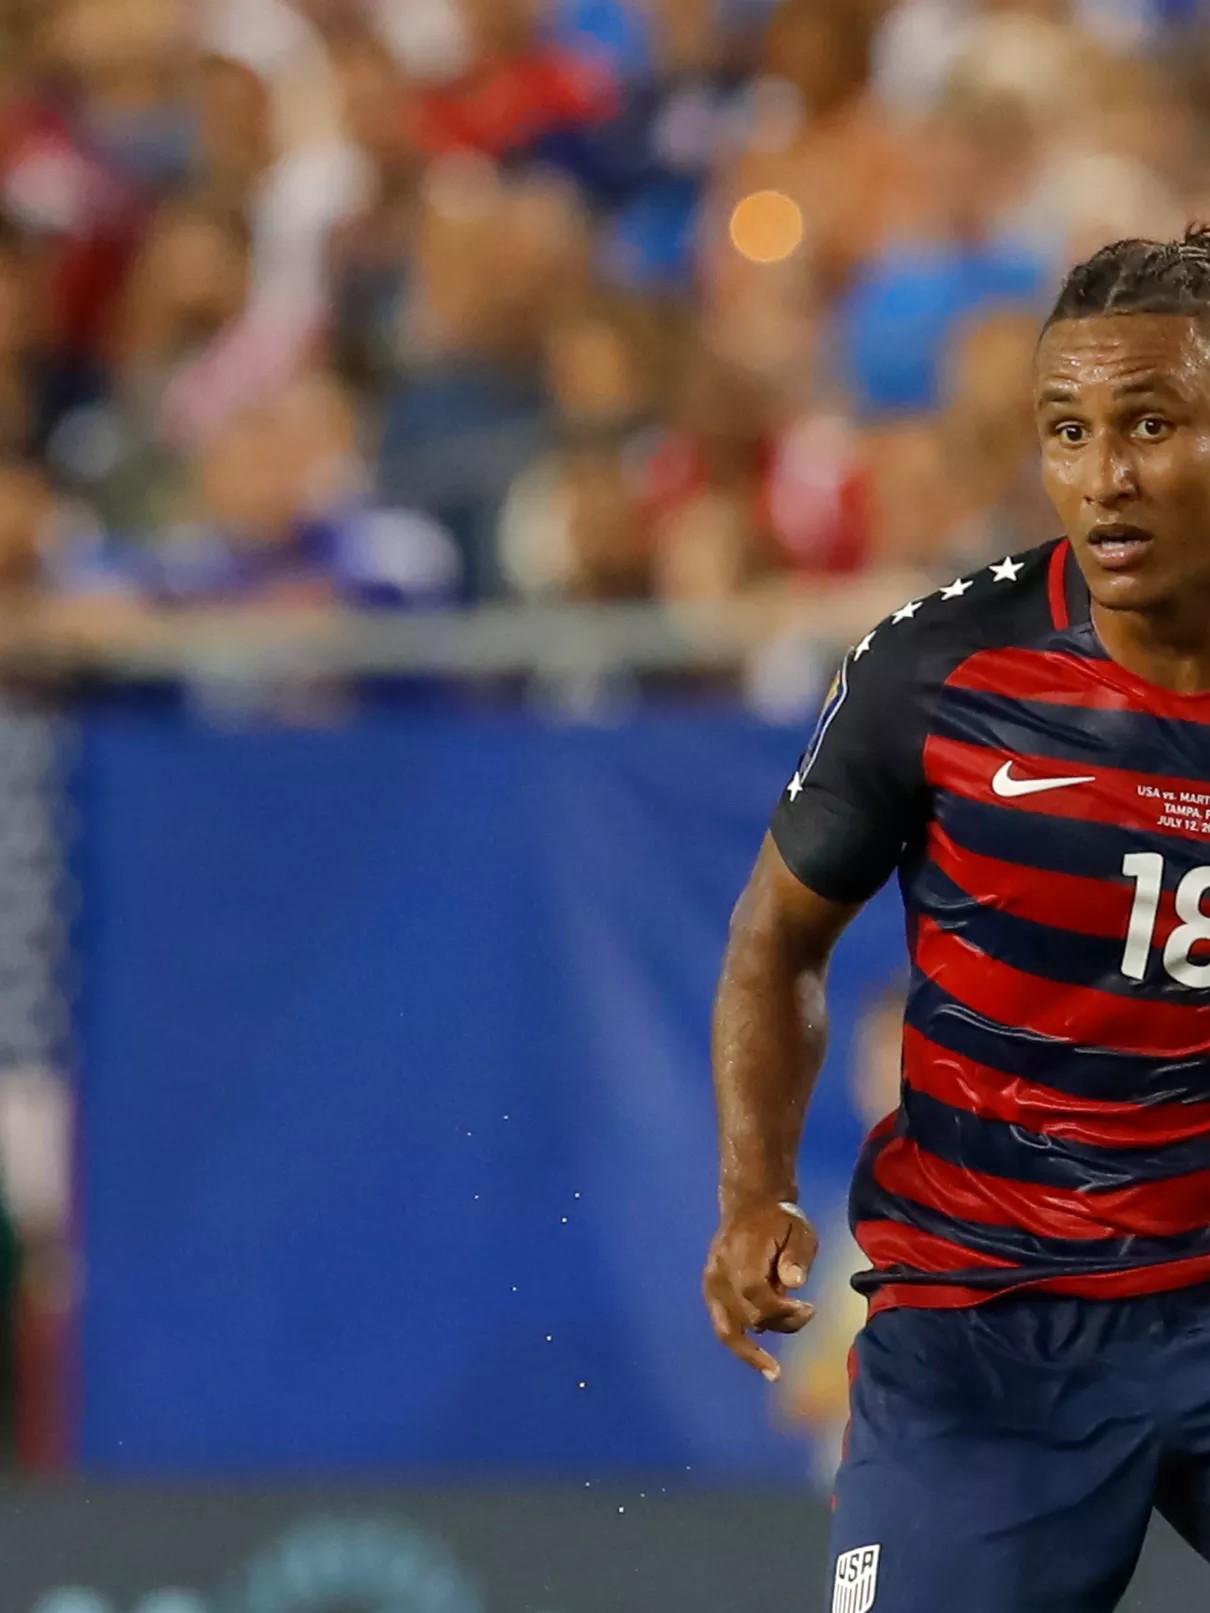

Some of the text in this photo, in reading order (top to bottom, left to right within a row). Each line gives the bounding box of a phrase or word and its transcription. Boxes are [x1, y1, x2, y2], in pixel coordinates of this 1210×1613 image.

[1137, 785, 1161, 798] USA
[1157, 816, 1182, 828] JULY
[838, 1550, 875, 1582] USA
